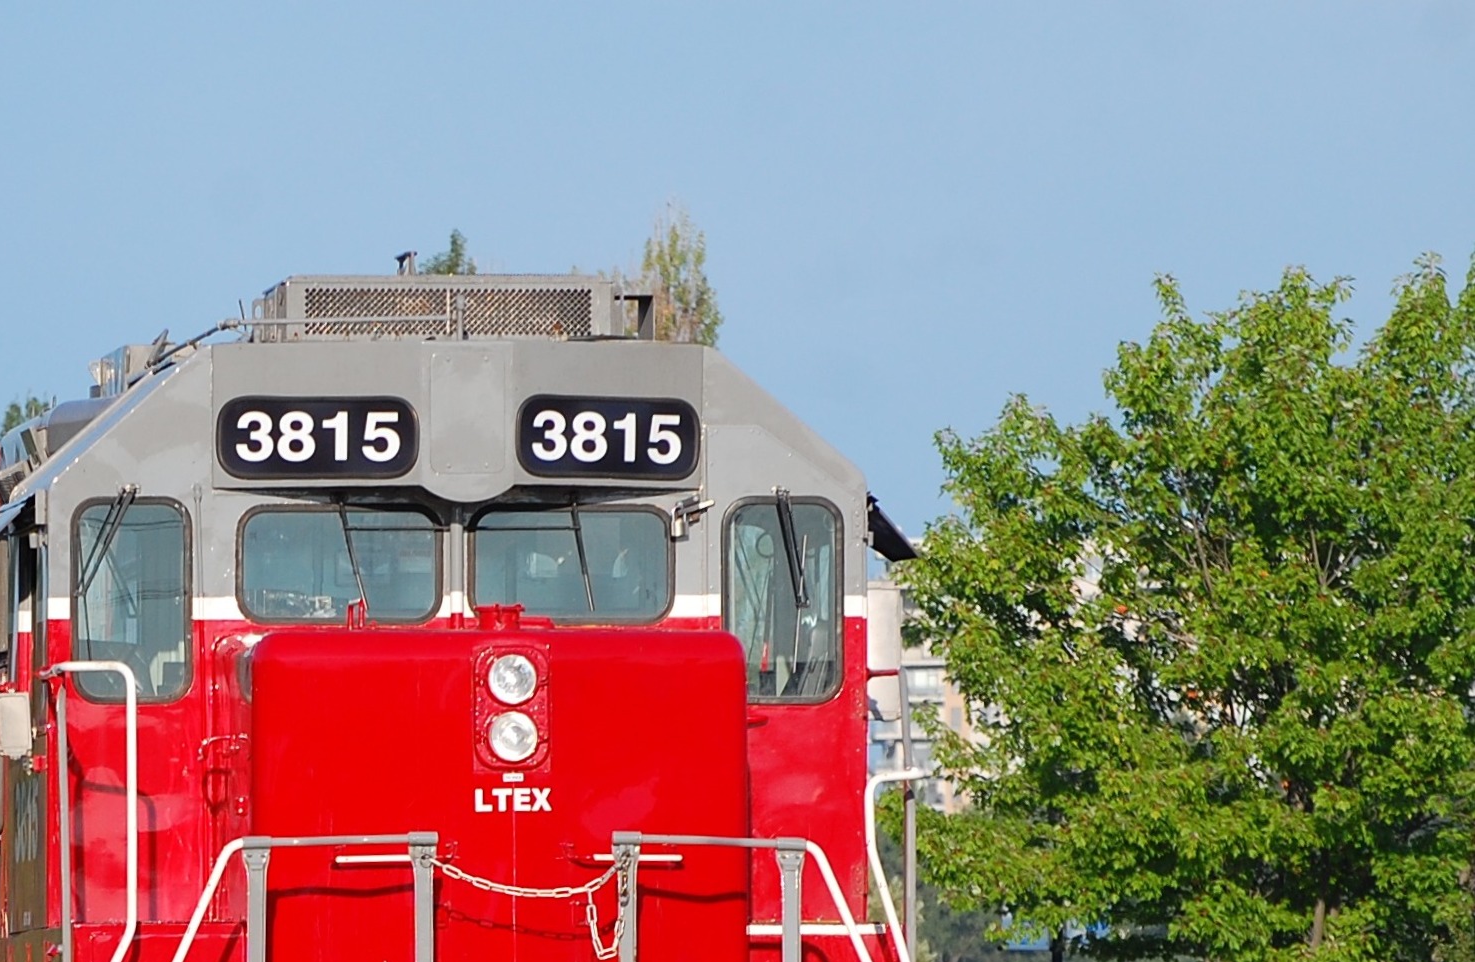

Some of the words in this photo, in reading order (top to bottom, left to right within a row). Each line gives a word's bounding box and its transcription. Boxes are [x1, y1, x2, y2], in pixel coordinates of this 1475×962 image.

[235, 410, 402, 463] 3815
[531, 410, 683, 465] 3815
[474, 788, 552, 813] LTEX
